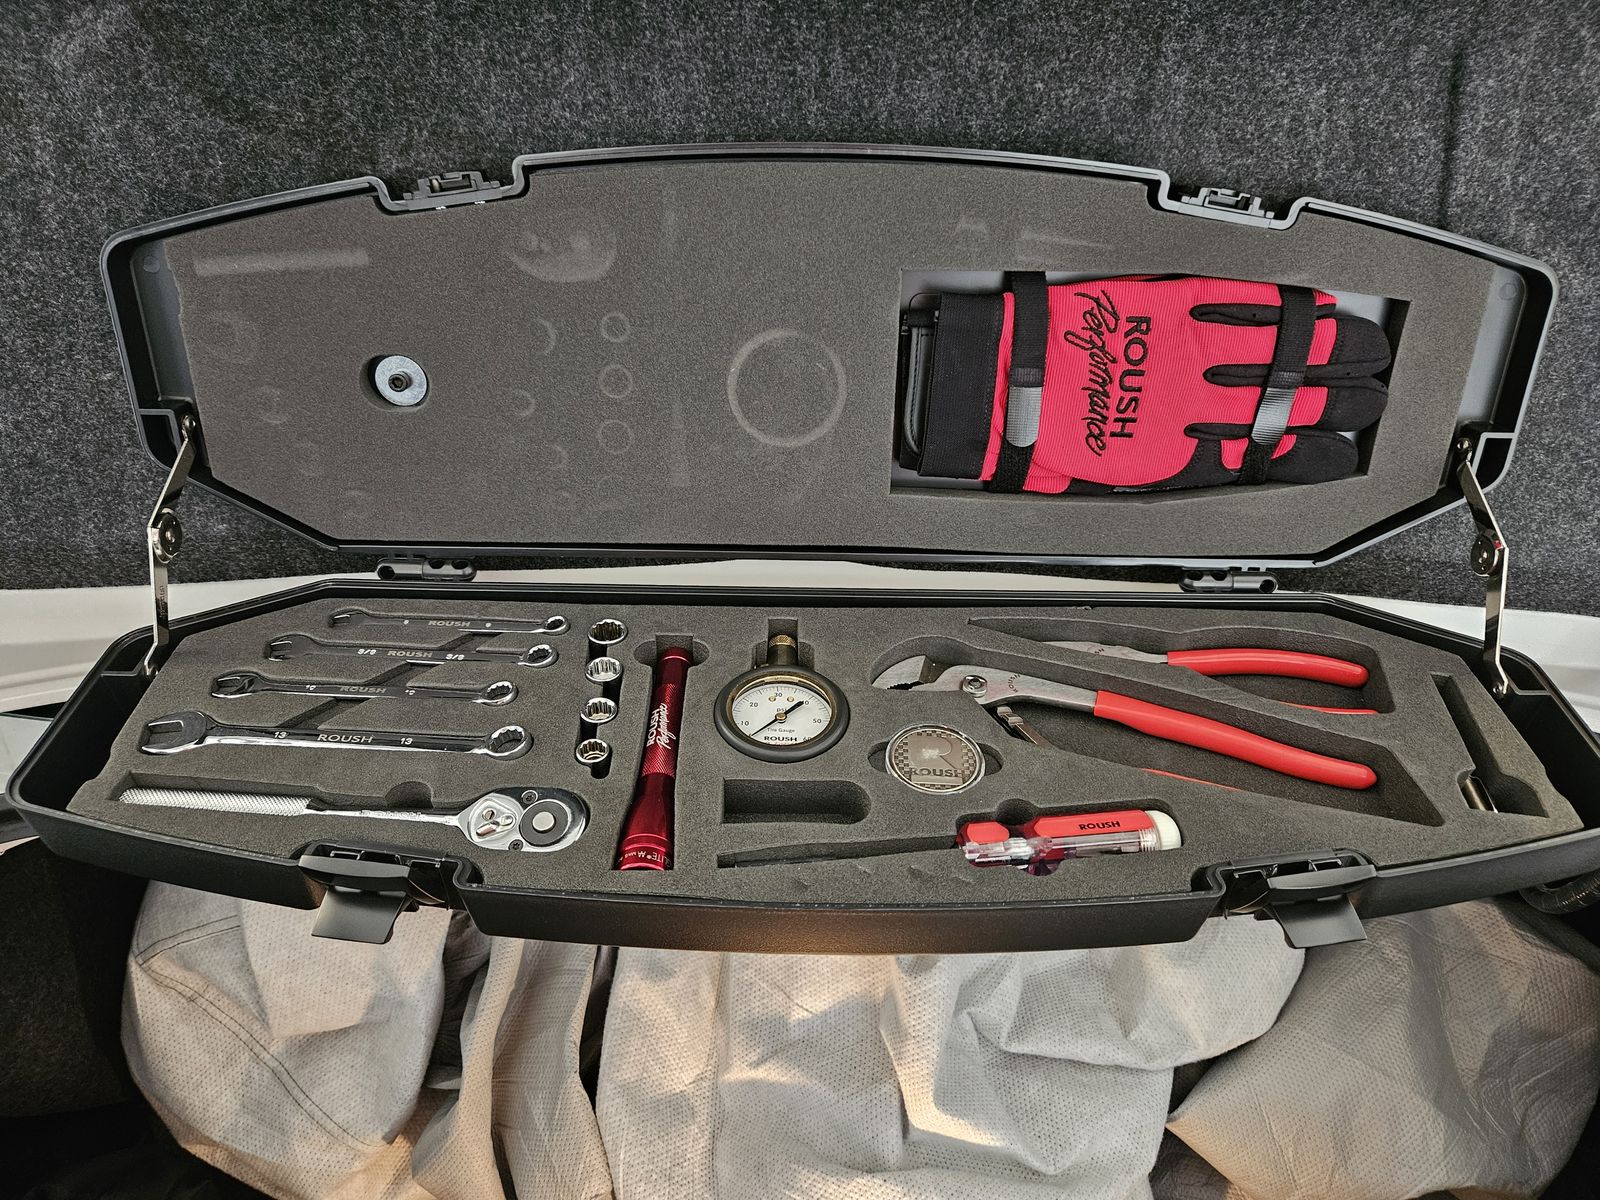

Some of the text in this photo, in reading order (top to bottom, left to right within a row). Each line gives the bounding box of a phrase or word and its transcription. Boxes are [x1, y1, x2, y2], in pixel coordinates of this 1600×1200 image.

[1063, 289, 1121, 458] Performance
[1109, 315, 1152, 439] ROUSH
[427, 619, 471, 628] ROUSH
[386, 650, 433, 658] ROUSH
[339, 685, 387, 694] ROUSH
[646, 708, 661, 747] ROUSH
[656, 702, 677, 750] Performance
[273, 730, 414, 745] 13 ROUSH 13
[909, 767, 963, 777] ROUSH
[1079, 820, 1121, 831] ROUSH
